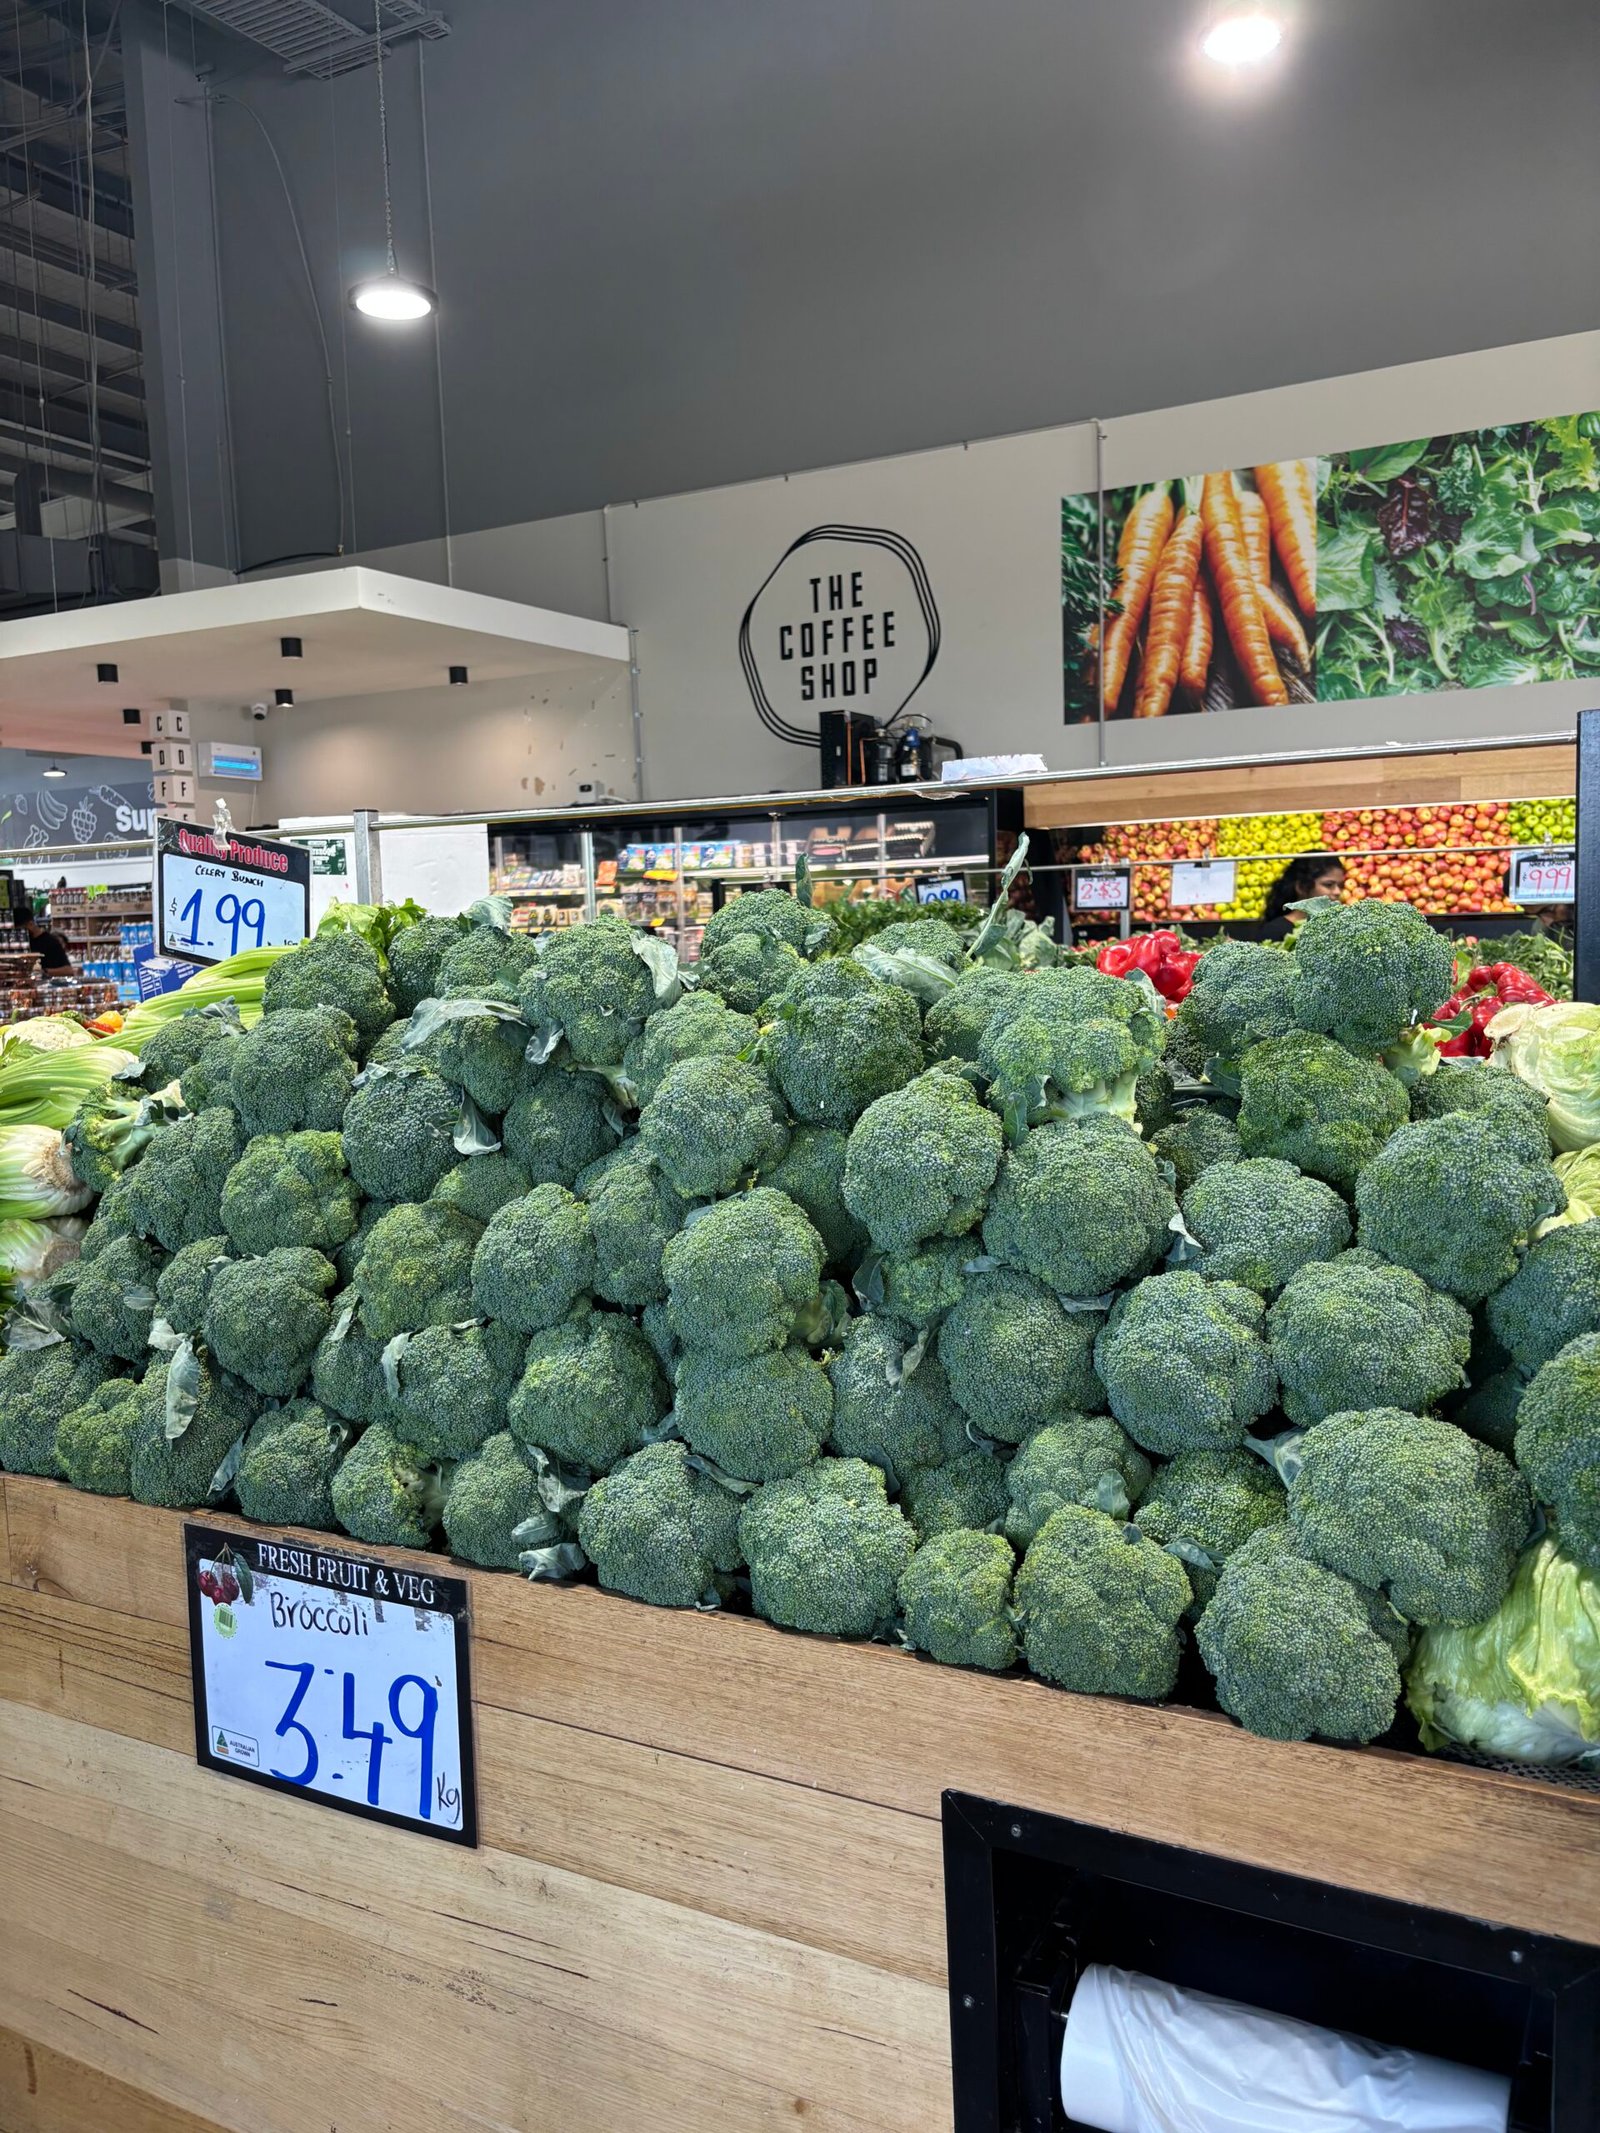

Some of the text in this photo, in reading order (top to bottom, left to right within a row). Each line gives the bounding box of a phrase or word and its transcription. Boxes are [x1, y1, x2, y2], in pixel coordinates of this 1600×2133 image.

[809, 571, 864, 613] THE
[779, 611, 896, 661] COFFEE
[801, 658, 878, 701] SHOP
[195, 865, 264, 888] CELERY BUNCH
[229, 839, 289, 873] Produce
[1080, 882, 1093, 900] 2
[257, 1543, 436, 1604] FRESH FRUIT & VEG
[270, 1591, 369, 1636] Broccoli
[229, 1740, 256, 1753] AUSTRALIAN
